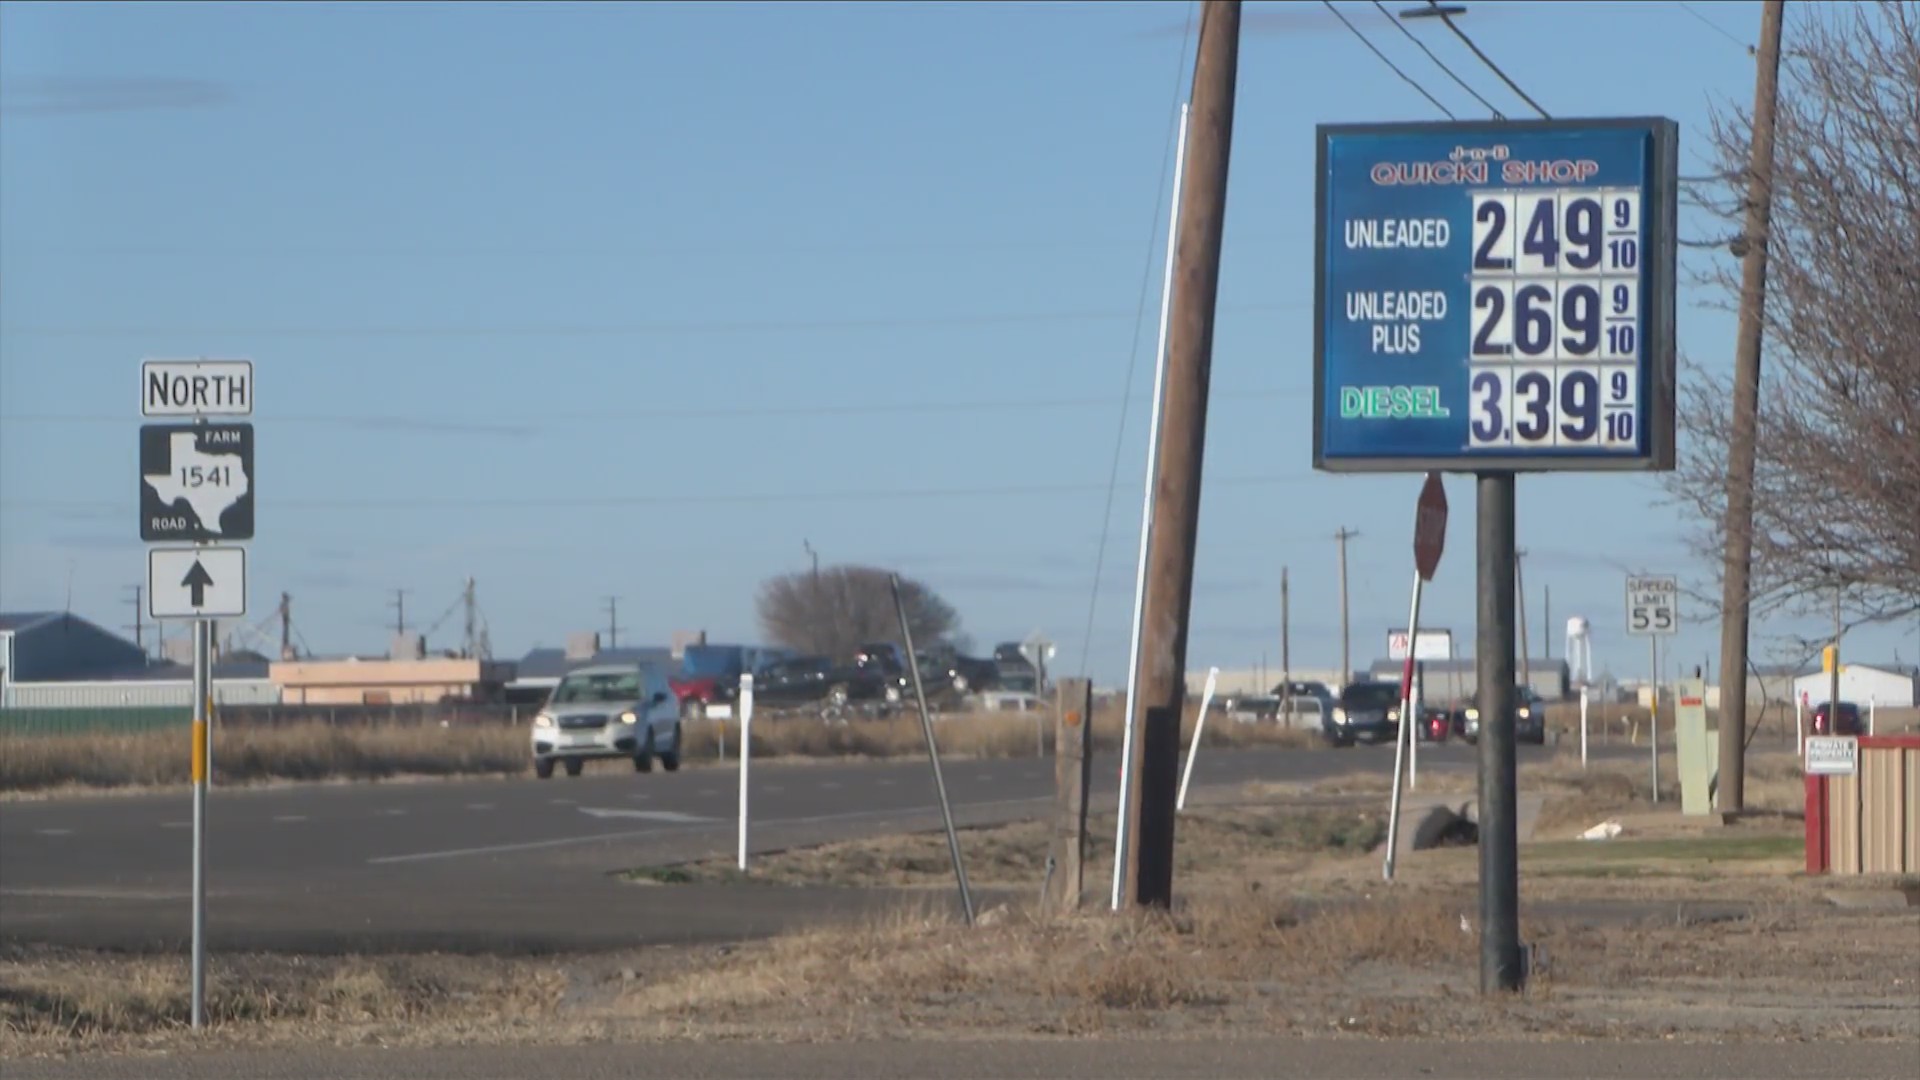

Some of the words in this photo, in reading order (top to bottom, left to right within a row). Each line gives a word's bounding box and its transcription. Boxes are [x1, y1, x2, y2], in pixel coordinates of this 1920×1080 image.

[1370, 162, 1489, 186] QUICKI
[1502, 159, 1599, 183] SHOP
[1344, 218, 1450, 248] UNLEADED
[1474, 197, 1603, 271] 2.49
[1346, 291, 1448, 321] UNLEADED
[1472, 283, 1601, 356] 2.69
[1371, 323, 1421, 354] PLUS
[149, 371, 245, 407] NORTH
[1340, 385, 1450, 419] DIESEL
[1471, 370, 1600, 442] 3.39
[204, 430, 241, 444] FARM
[180, 465, 231, 488] 1541
[151, 517, 187, 531] ROAD
[1634, 594, 1667, 606] LIMIT
[1632, 607, 1671, 630] 55
